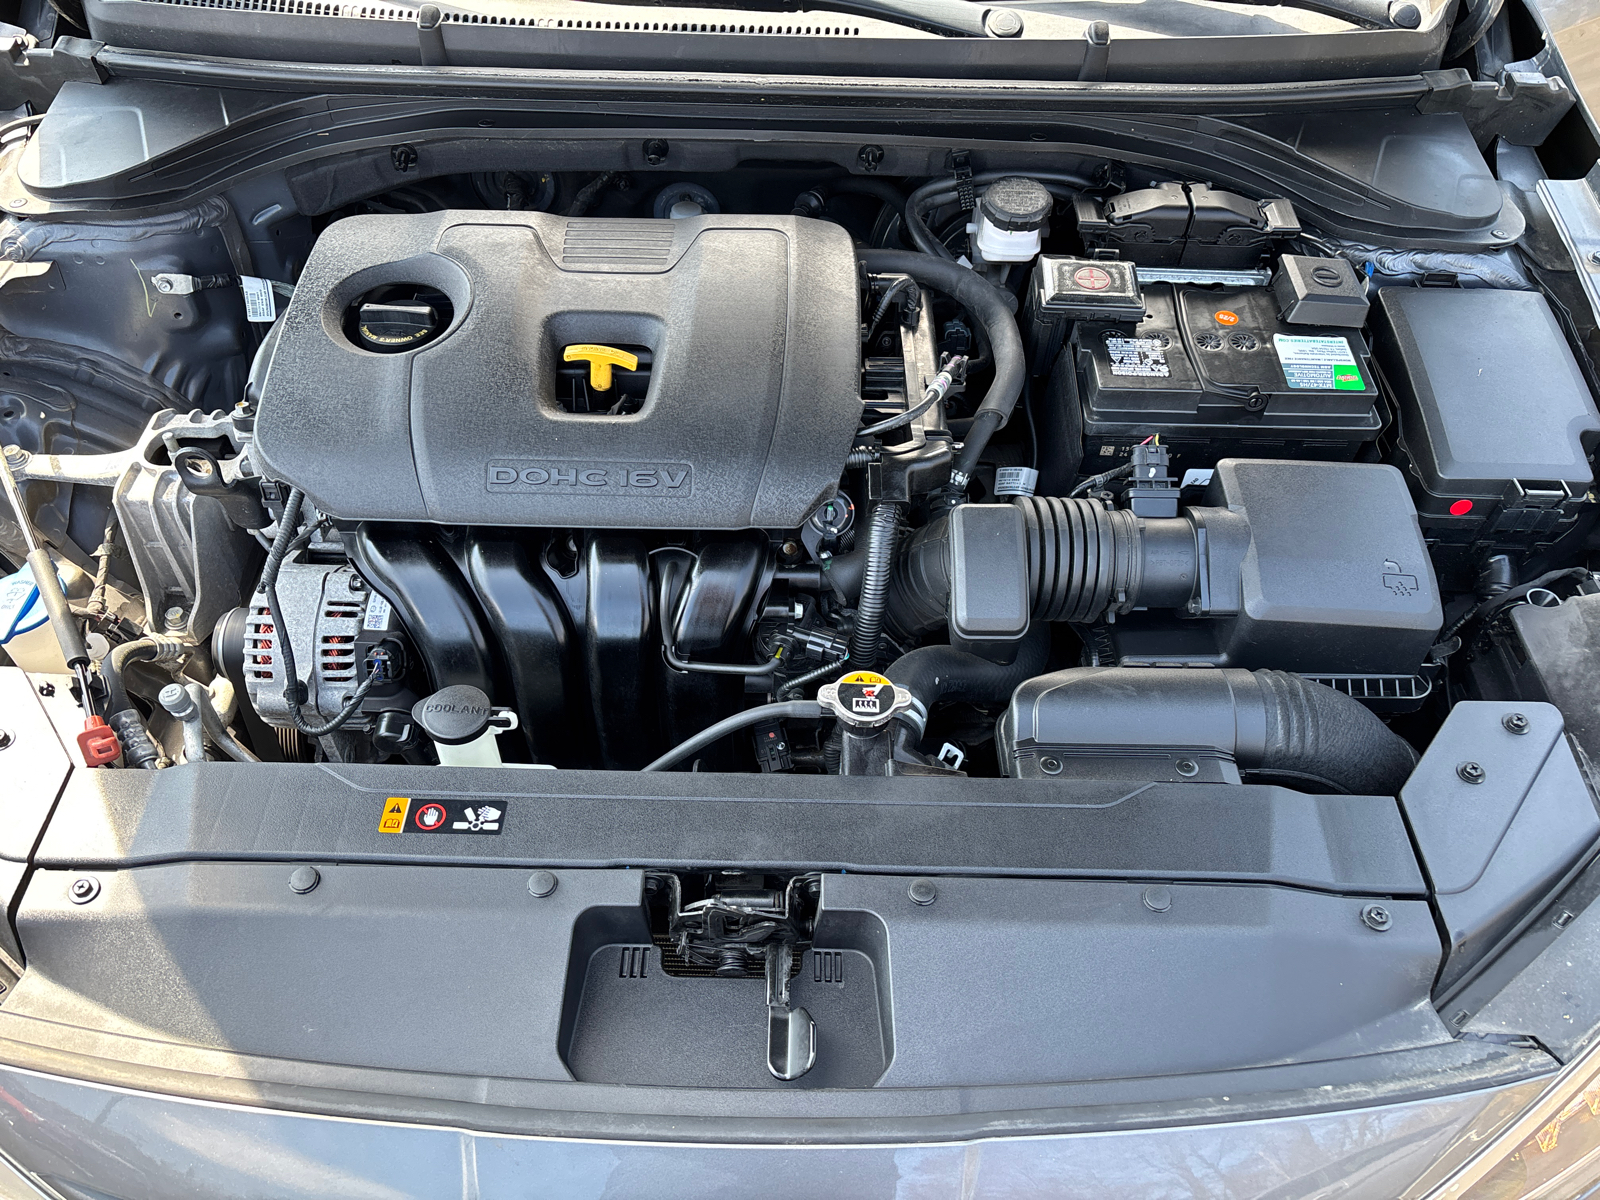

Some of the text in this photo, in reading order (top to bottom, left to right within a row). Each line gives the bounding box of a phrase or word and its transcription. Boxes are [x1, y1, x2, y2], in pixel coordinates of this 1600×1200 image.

[379, 335, 413, 343] OWNER'S
[414, 329, 428, 338] SEE
[489, 466, 689, 488] DOHC 16V
[426, 703, 489, 716] COOLANT
